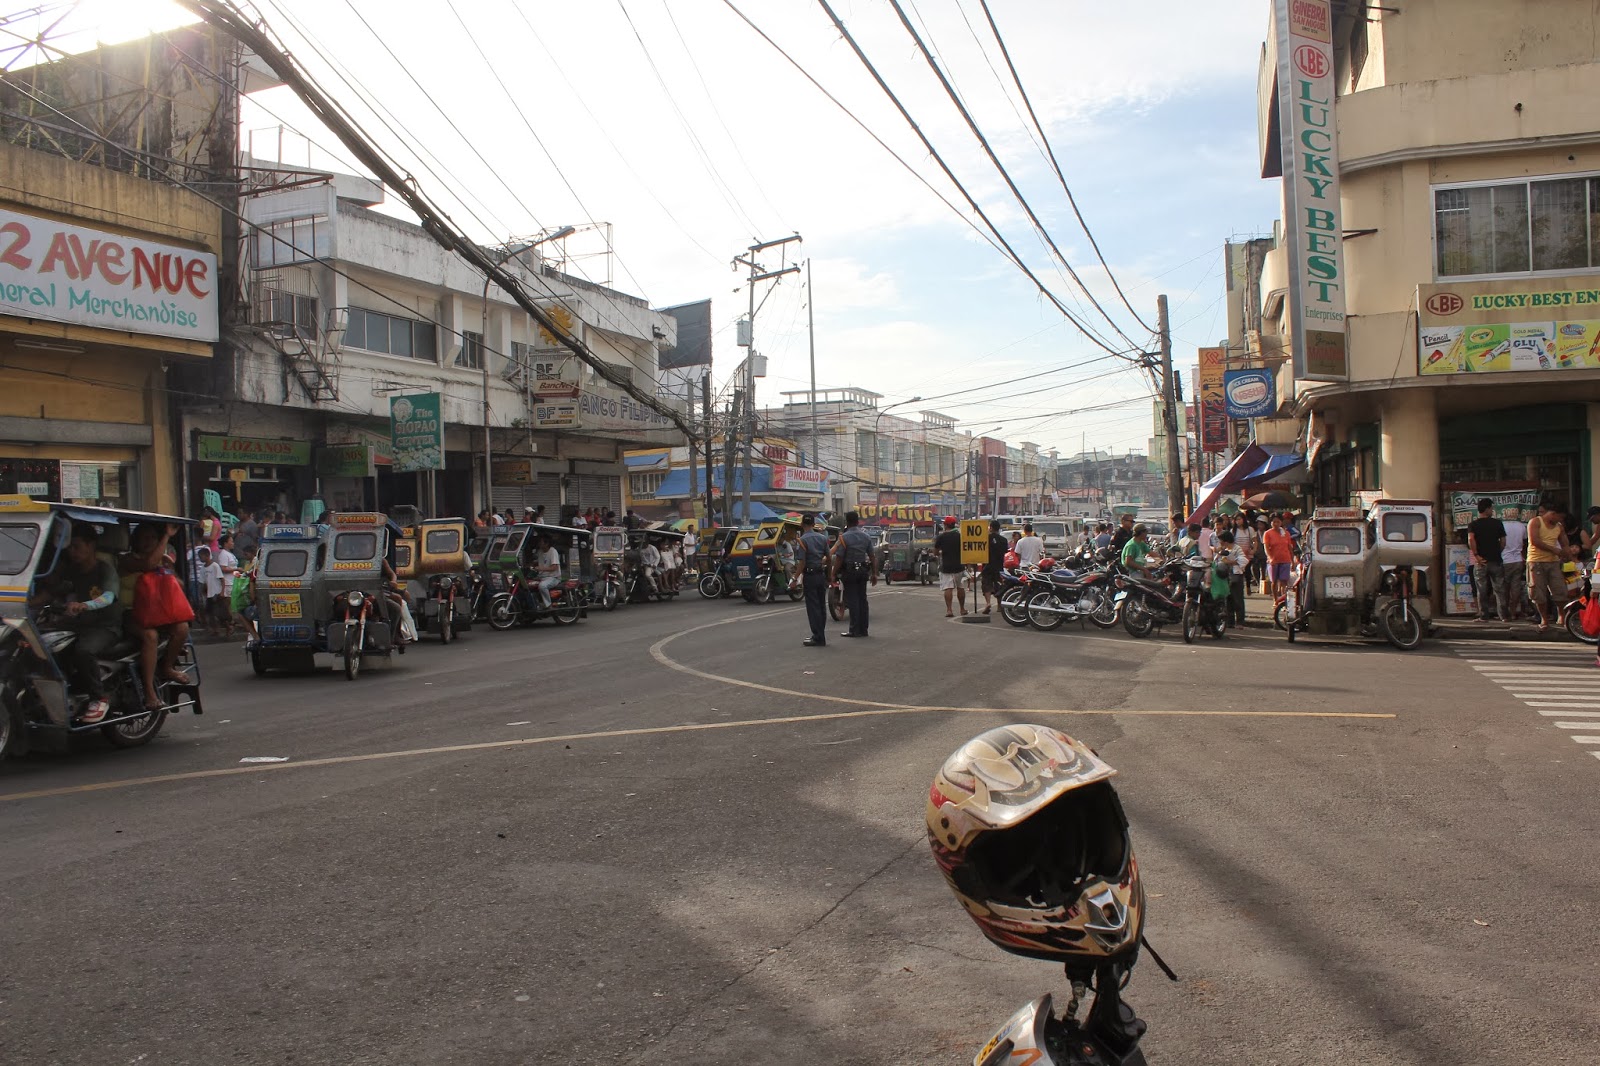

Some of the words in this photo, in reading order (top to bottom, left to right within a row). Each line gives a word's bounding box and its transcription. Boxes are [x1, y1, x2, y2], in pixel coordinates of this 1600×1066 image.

[1293, 1, 1326, 22] GINEBRA
[1293, 14, 1305, 26] SAN
[1305, 18, 1326, 31] MIGUEL
[1300, 48, 1324, 75] LBE
[1299, 79, 1333, 200] LUCKY
[1304, 207, 1338, 303] BEST
[68, 286, 198, 328] Merchandise
[1430, 295, 1460, 313] LBE
[1473, 294, 1528, 309] LUCKY
[1531, 292, 1573, 305] BEST
[1305, 305, 1344, 323] Enterprises
[536, 364, 553, 373] BF
[537, 406, 555, 420] BF
[570, 395, 617, 417] ANCO
[415, 408, 433, 419] The
[395, 420, 437, 434] SIOPAO
[396, 435, 435, 447] CENTER
[794, 469, 819, 482] MORALLO
[337, 515, 377, 524] TAURUS
[967, 525, 982, 536] NO
[963, 541, 987, 552] ENTRY
[1328, 581, 1352, 589] 1630
[272, 603, 299, 614] 1645
